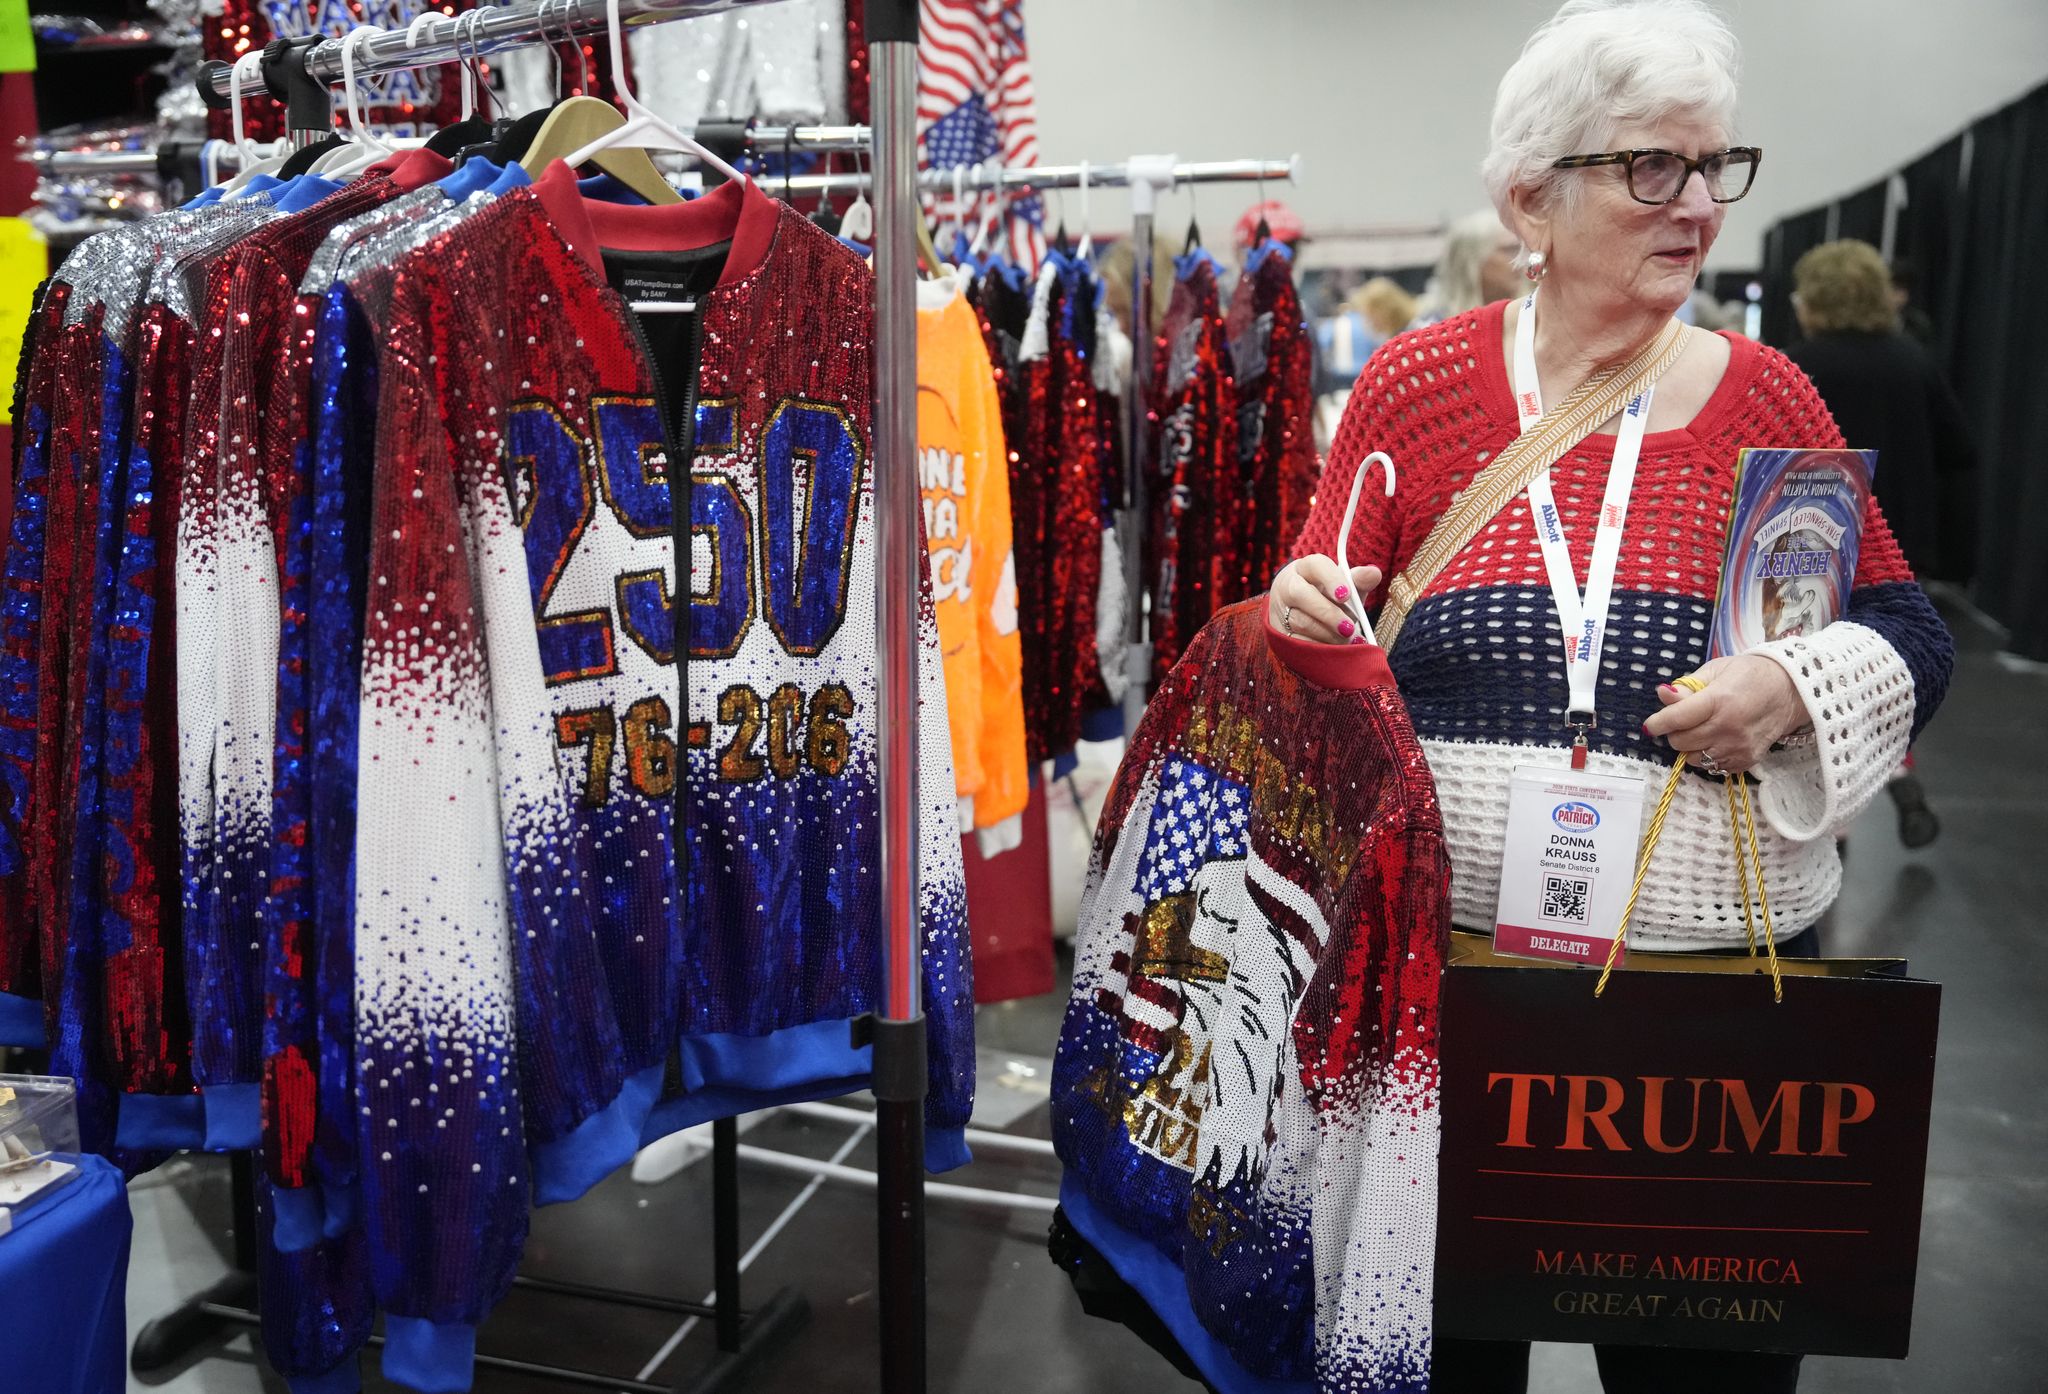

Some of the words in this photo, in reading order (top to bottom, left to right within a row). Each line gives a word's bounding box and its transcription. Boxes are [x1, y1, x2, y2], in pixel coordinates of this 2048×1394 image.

[624, 279, 684, 289] USATrumpStore.com
[641, 289, 649, 298] By
[650, 290, 668, 298] SANY
[1782, 482, 1811, 497] MARTIN
[1810, 484, 1839, 496] AMANDA
[1541, 504, 1561, 544] Abbott
[1760, 515, 1788, 541] SPANIEL
[1793, 511, 1841, 541] STAR-SPANGLED
[503, 394, 865, 688] 250
[1757, 551, 1832, 579] HENRY
[1577, 618, 1597, 662] Abbott
[1558, 810, 1595, 825] PATRICK
[1550, 834, 1596, 849] DONNA
[1539, 859, 1566, 870] Senate
[1568, 862, 1594, 873] District
[1595, 866, 1600, 874] 8
[1545, 847, 1597, 863] KRAUSS
[1529, 935, 1590, 956] DELEGATE
[1486, 1072, 1876, 1157] TRUMP
[1533, 1249, 1638, 1279] MAKE
[1643, 1255, 1803, 1284] AMERICA
[1553, 1290, 1667, 1318] GREAT
[1672, 1295, 1784, 1323] AGAIN
